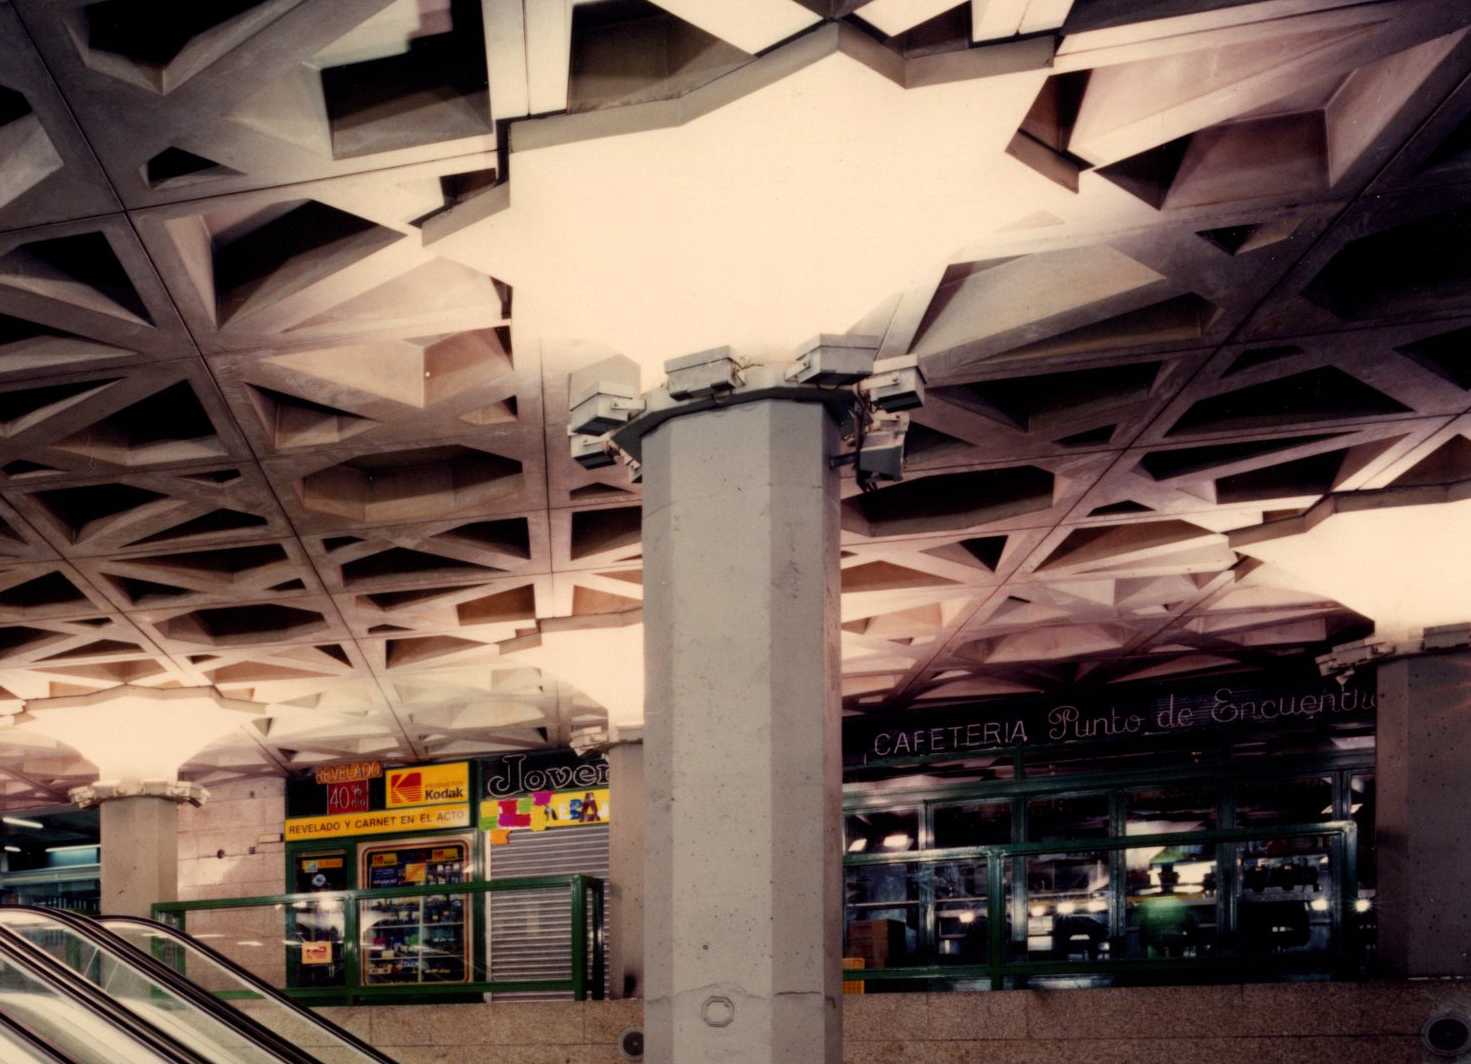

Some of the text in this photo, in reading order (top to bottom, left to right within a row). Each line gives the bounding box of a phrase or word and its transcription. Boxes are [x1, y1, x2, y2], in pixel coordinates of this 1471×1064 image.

[874, 720, 1027, 756] CAFETERIA
[1047, 705, 1146, 740] Punto
[1157, 693, 1194, 729] de
[316, 761, 380, 781] REVELADO
[425, 787, 463, 799] Kodak
[289, 811, 465, 834] REVELADO Y CARNET EN EL ACTO
